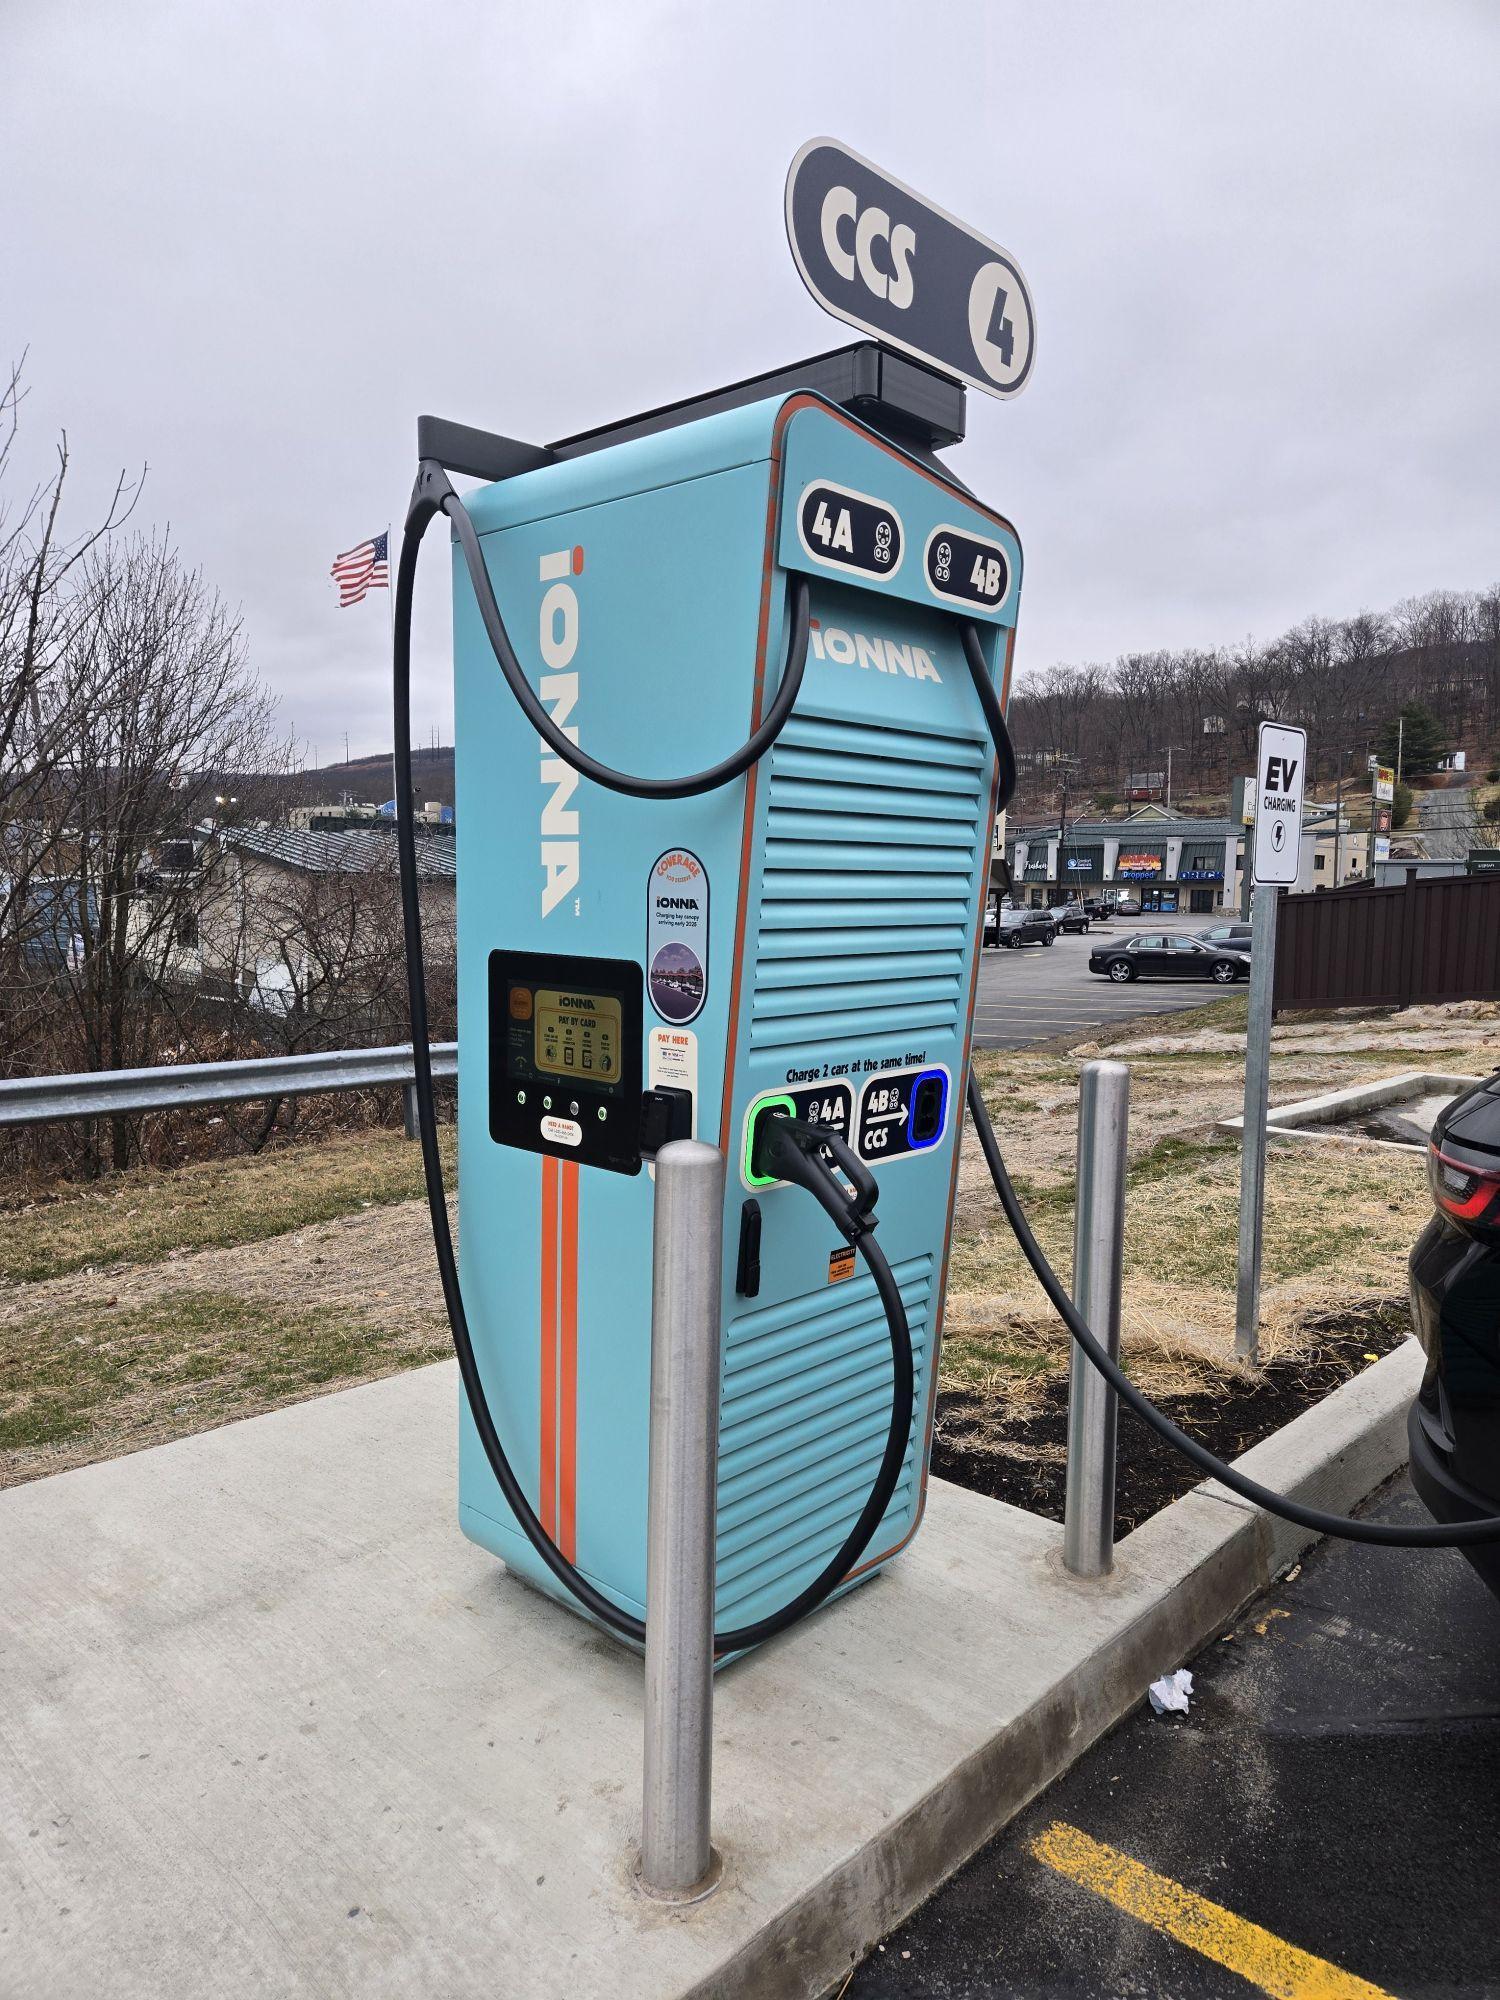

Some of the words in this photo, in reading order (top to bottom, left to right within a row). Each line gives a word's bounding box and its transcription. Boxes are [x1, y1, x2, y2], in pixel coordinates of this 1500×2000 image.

[820, 185, 916, 309] CCS
[985, 287, 1014, 368] 4
[812, 501, 853, 554] 4A
[969, 554, 1001, 597] 4B
[1265, 756, 1298, 793] EV
[1264, 795, 1296, 813] CHARGING
[656, 853, 701, 878] COVERAGE
[558, 1016, 570, 1025] PAY
[571, 1017, 579, 1027] BY
[580, 1018, 597, 1029] CARD
[657, 1034, 670, 1043] PAY
[672, 1035, 689, 1046] HERE
[786, 1067, 820, 1084] Charge
[823, 1066, 829, 1077] 2
[831, 1063, 849, 1075] cars
[851, 1061, 861, 1072] at
[863, 1058, 878, 1071] the
[880, 1056, 903, 1069] same
[905, 1051, 926, 1066] time!
[820, 1096, 844, 1122] 4A
[867, 1088, 889, 1114] 4B
[863, 1127, 888, 1151] CCS
